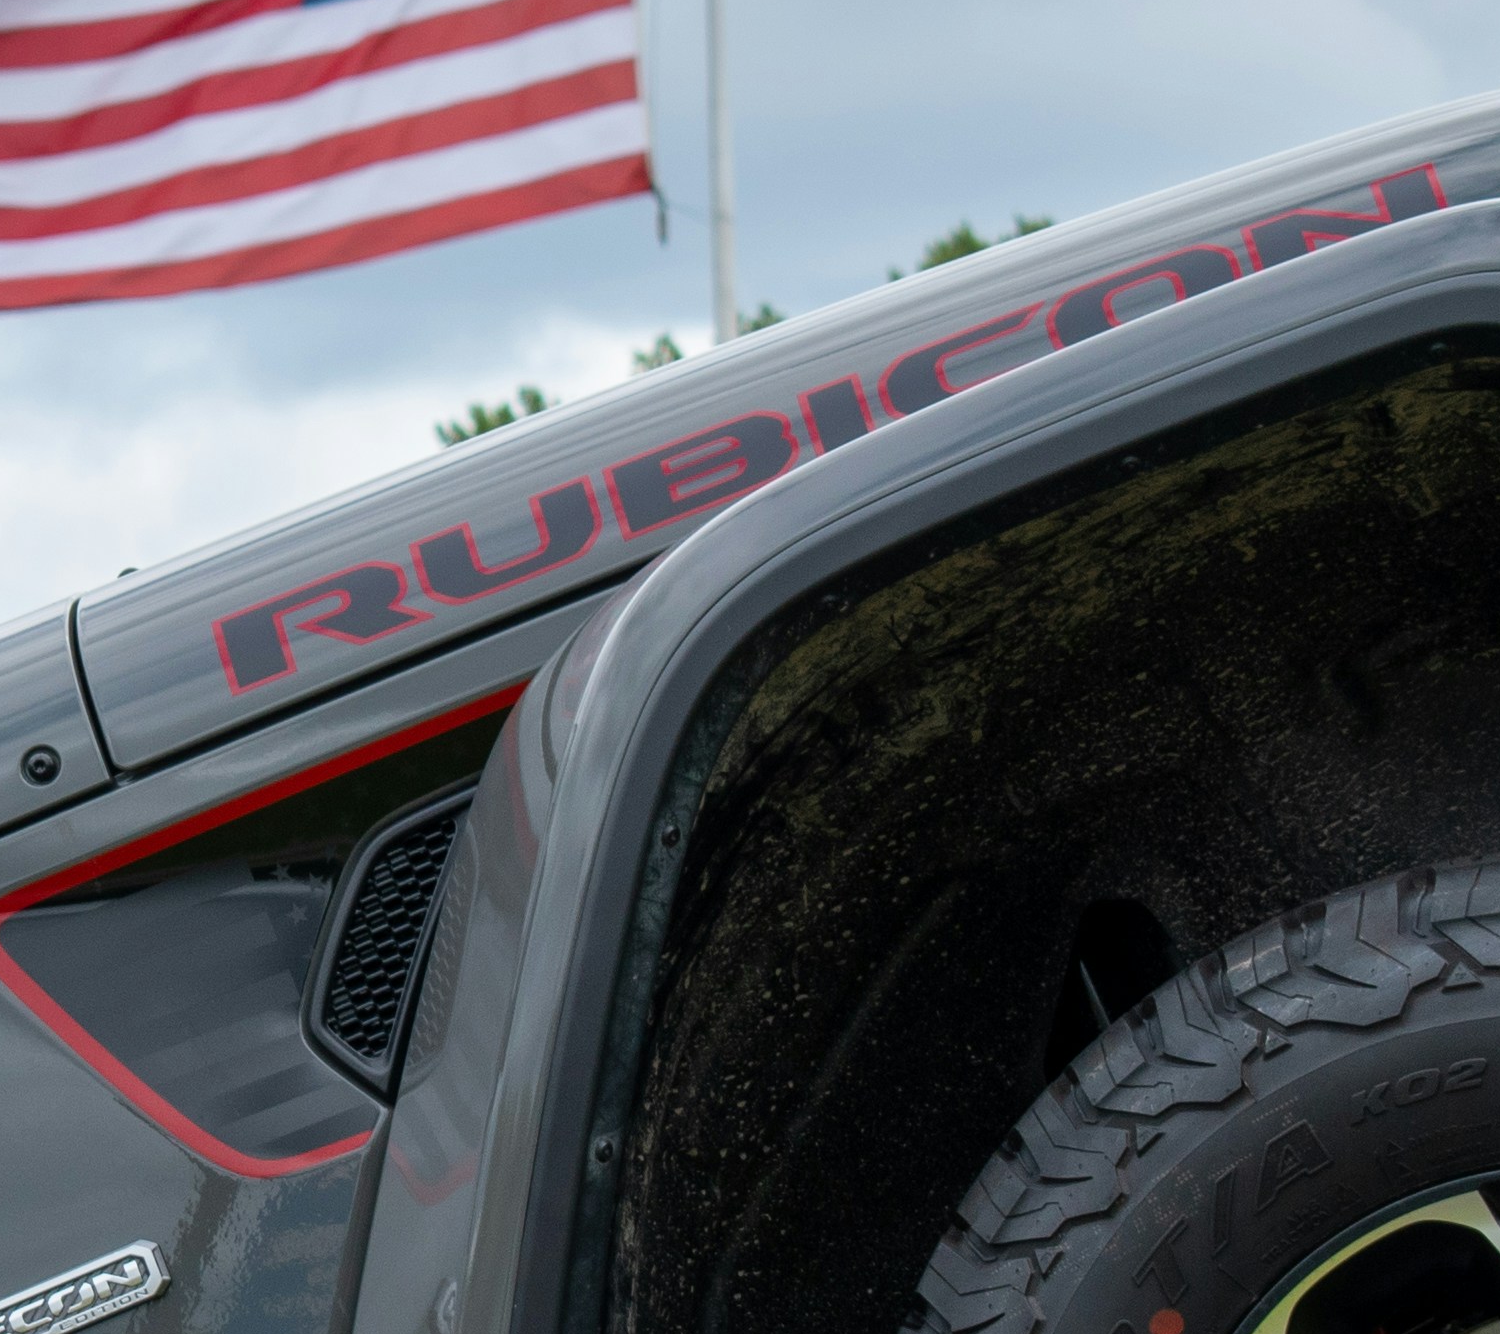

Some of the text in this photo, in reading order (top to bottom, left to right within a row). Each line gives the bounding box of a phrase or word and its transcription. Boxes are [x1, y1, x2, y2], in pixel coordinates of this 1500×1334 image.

[211, 162, 1451, 697] RUBICON
[1350, 1056, 1489, 1125] KO2
[58, 1287, 149, 1331] EDITION
